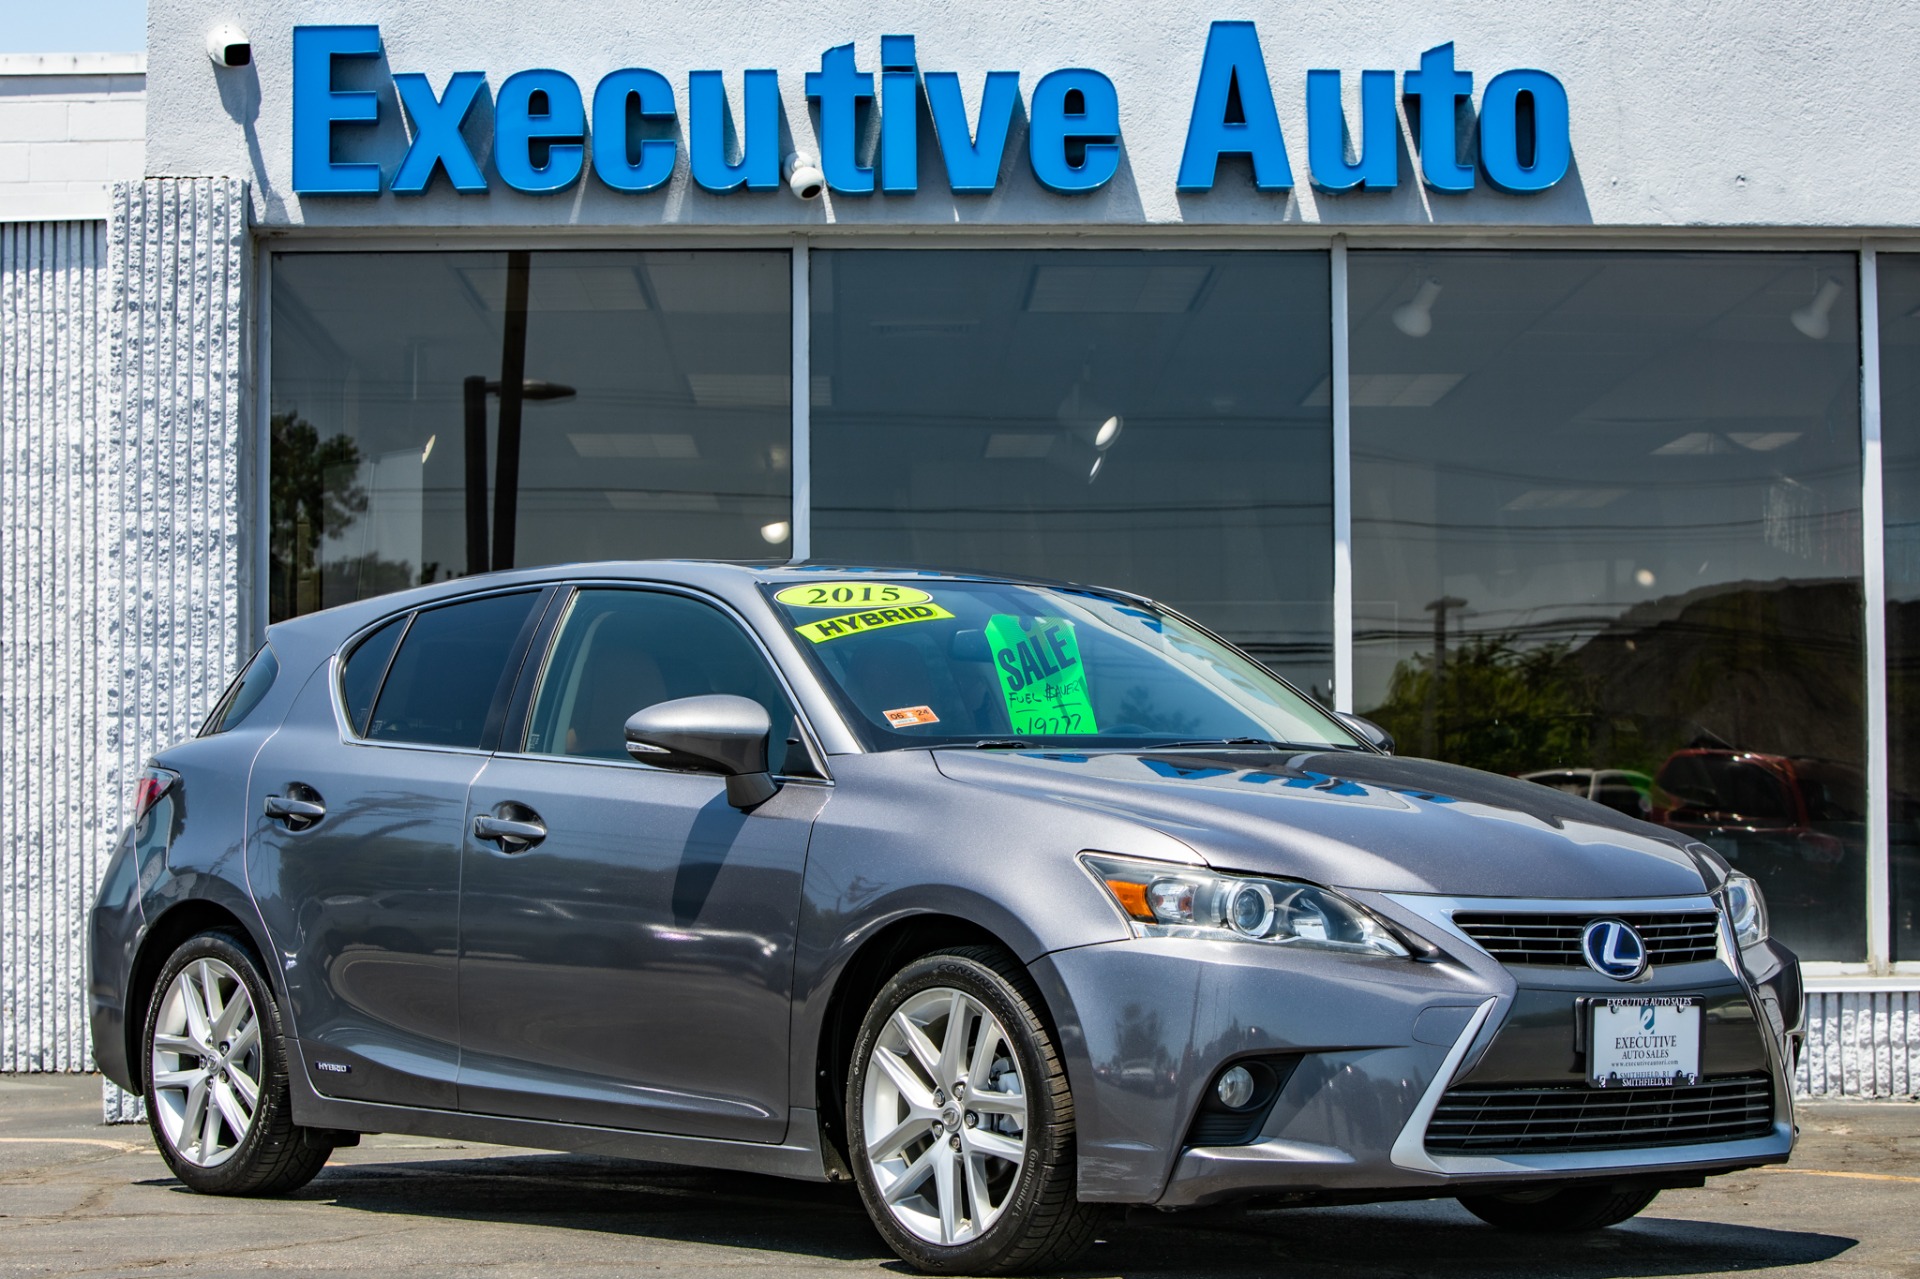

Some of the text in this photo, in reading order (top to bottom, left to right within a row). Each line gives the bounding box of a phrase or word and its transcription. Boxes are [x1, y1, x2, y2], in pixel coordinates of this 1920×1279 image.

[292, 20, 1570, 195] Executive Auto
[807, 587, 900, 605] 2015
[815, 606, 934, 636] HYBRID
[997, 625, 1077, 692] SALE
[1008, 692, 1042, 708] FUEL
[890, 712, 905, 720] 06
[1607, 997, 1692, 1007] EXECUTIVE AUTO SALES
[1615, 1035, 1677, 1050] EXECUTIVE
[1622, 1049, 1669, 1060] AUTO SALES
[318, 1062, 347, 1072] HYBRID
[1665, 1078, 1673, 1086] RI
